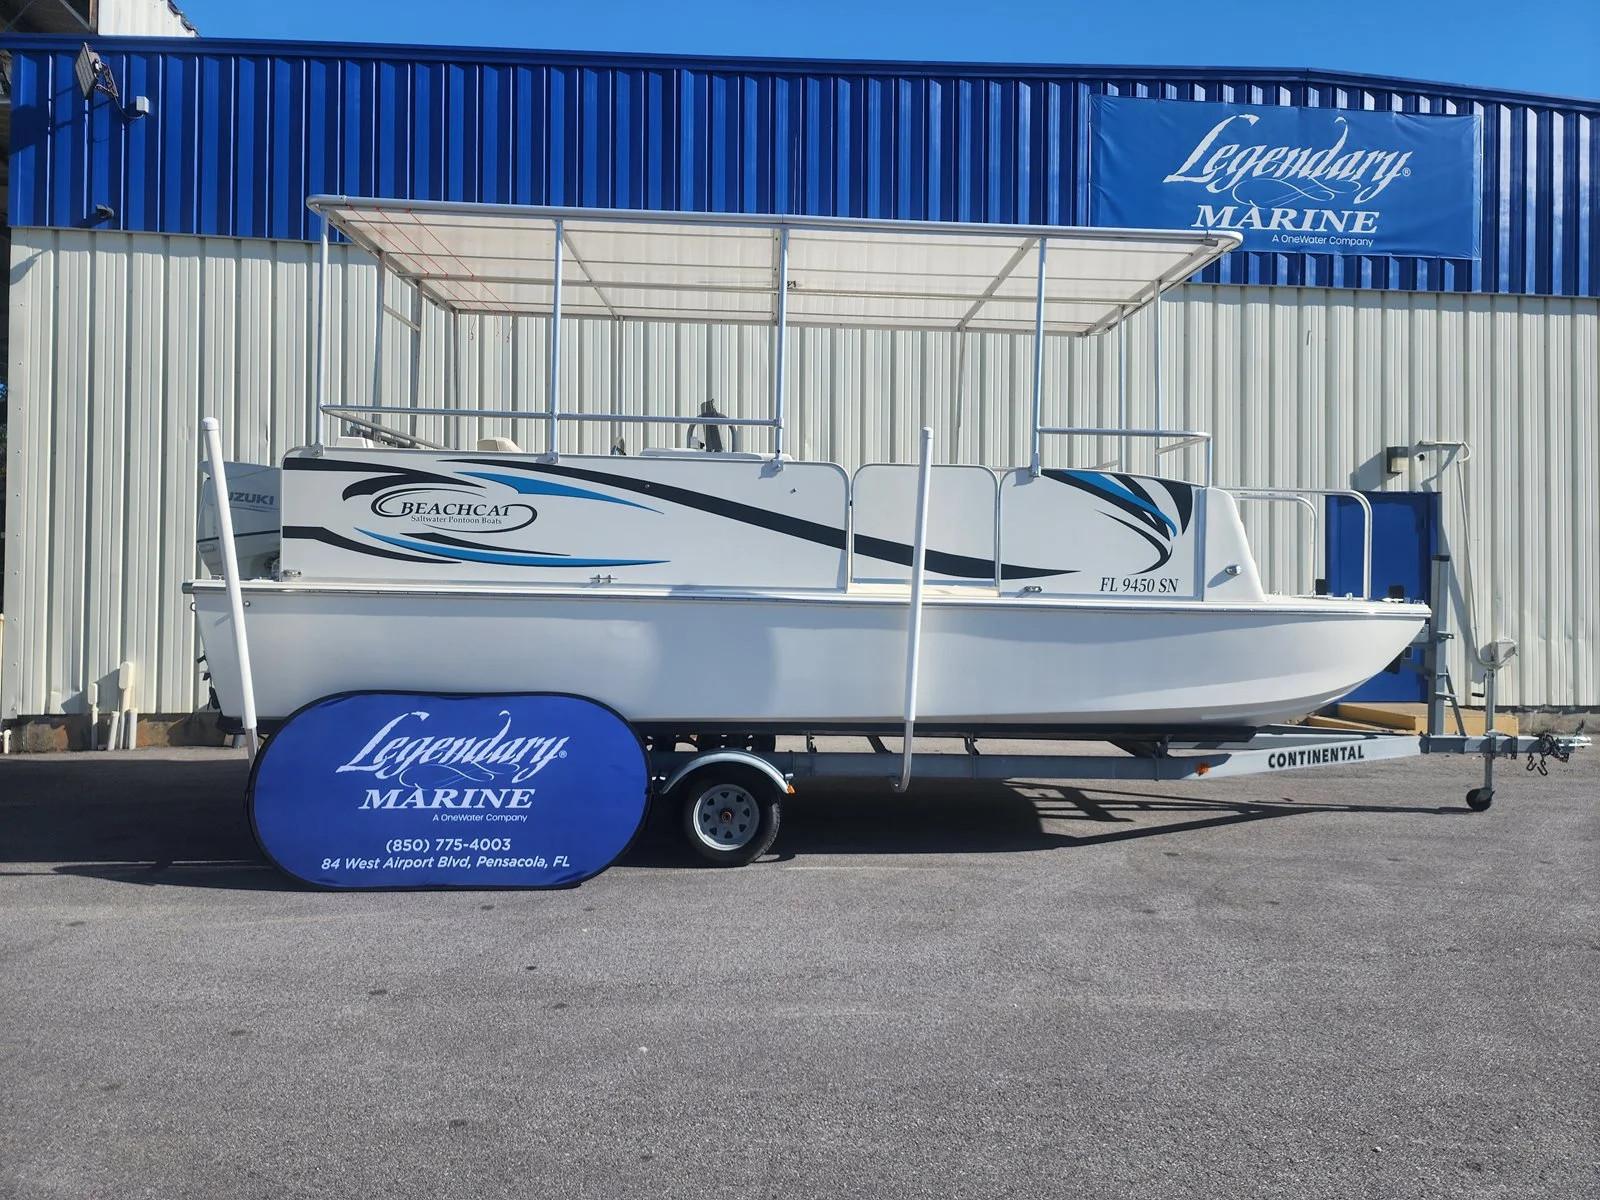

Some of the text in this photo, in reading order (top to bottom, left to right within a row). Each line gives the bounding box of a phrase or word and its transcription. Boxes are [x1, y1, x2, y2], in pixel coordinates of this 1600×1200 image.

[1191, 205, 1380, 234] MARINE
[1272, 234, 1374, 248] A OneWater Company
[401, 501, 510, 517] BEACHCAT
[411, 515, 503, 526] Saltwater Pontoon Boats
[1099, 577, 1180, 593] FL 9450 SN
[1268, 745, 1365, 769] CONTINENTAL
[358, 787, 535, 810] MARINE
[432, 813, 528, 823] A OneWater Company
[385, 838, 512, 853] (850) 775-4003
[321, 855, 571, 871] 84 West Airport Blvd, Pensacola, FL
